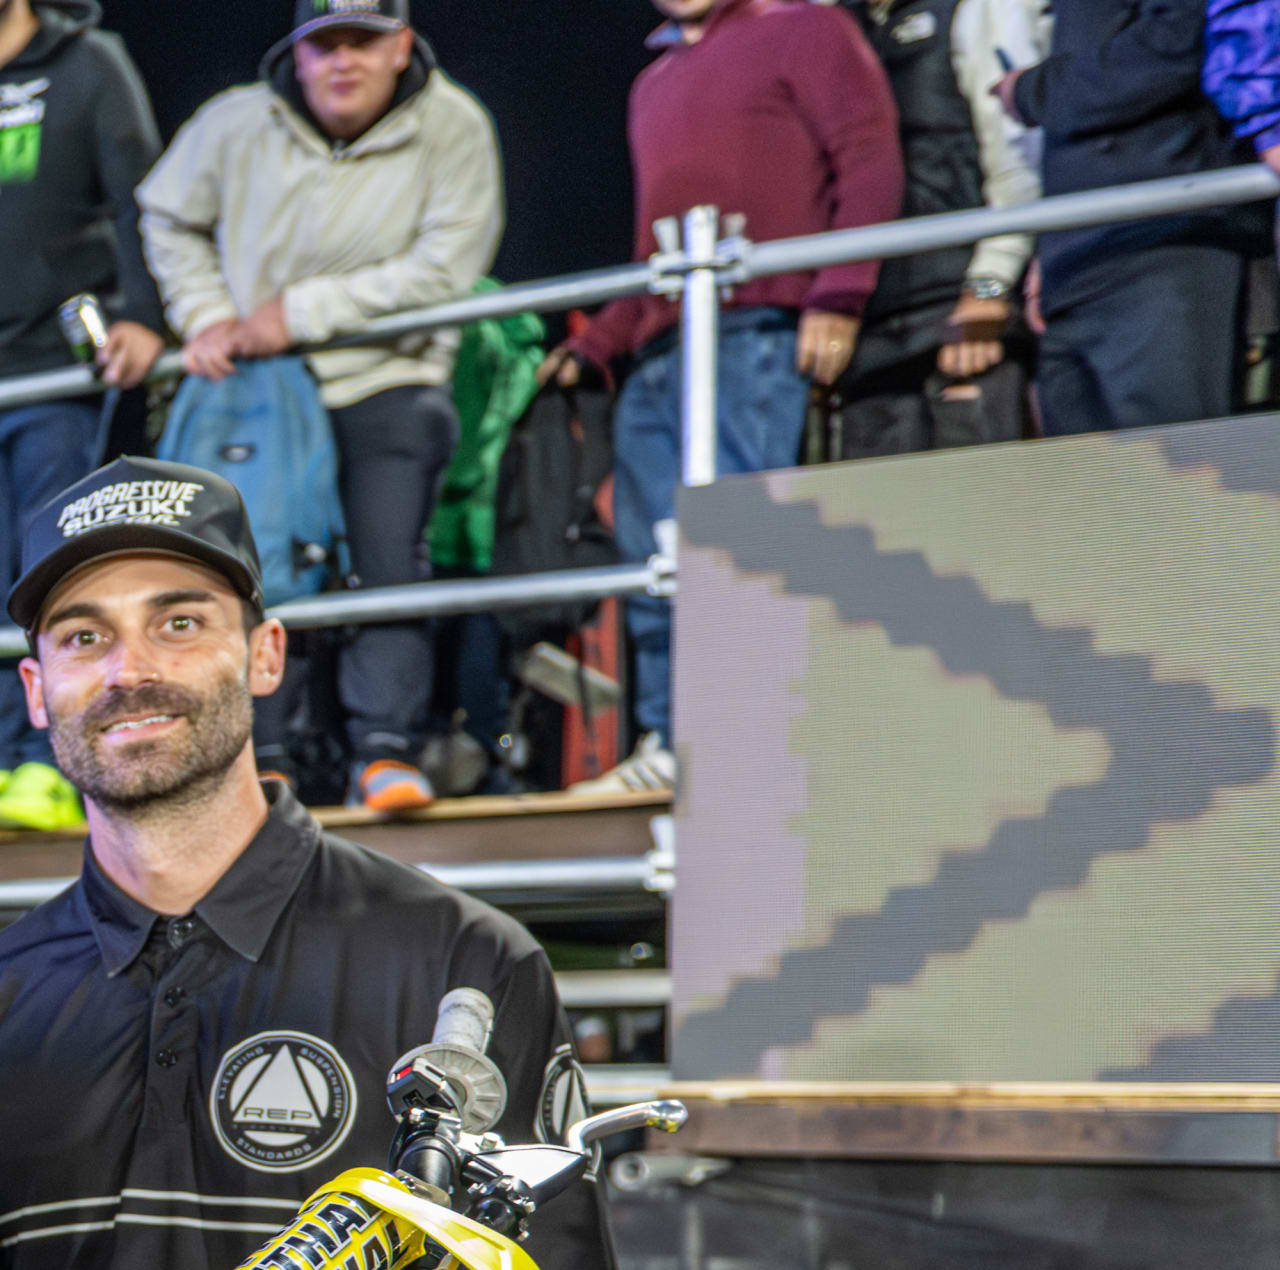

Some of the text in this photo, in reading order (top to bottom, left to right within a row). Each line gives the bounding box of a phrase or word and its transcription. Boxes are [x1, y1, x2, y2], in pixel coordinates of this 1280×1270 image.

[57, 479, 204, 529] PROGRESSIVE
[62, 499, 192, 538] SUZUKI
[243, 1106, 314, 1121] REP
